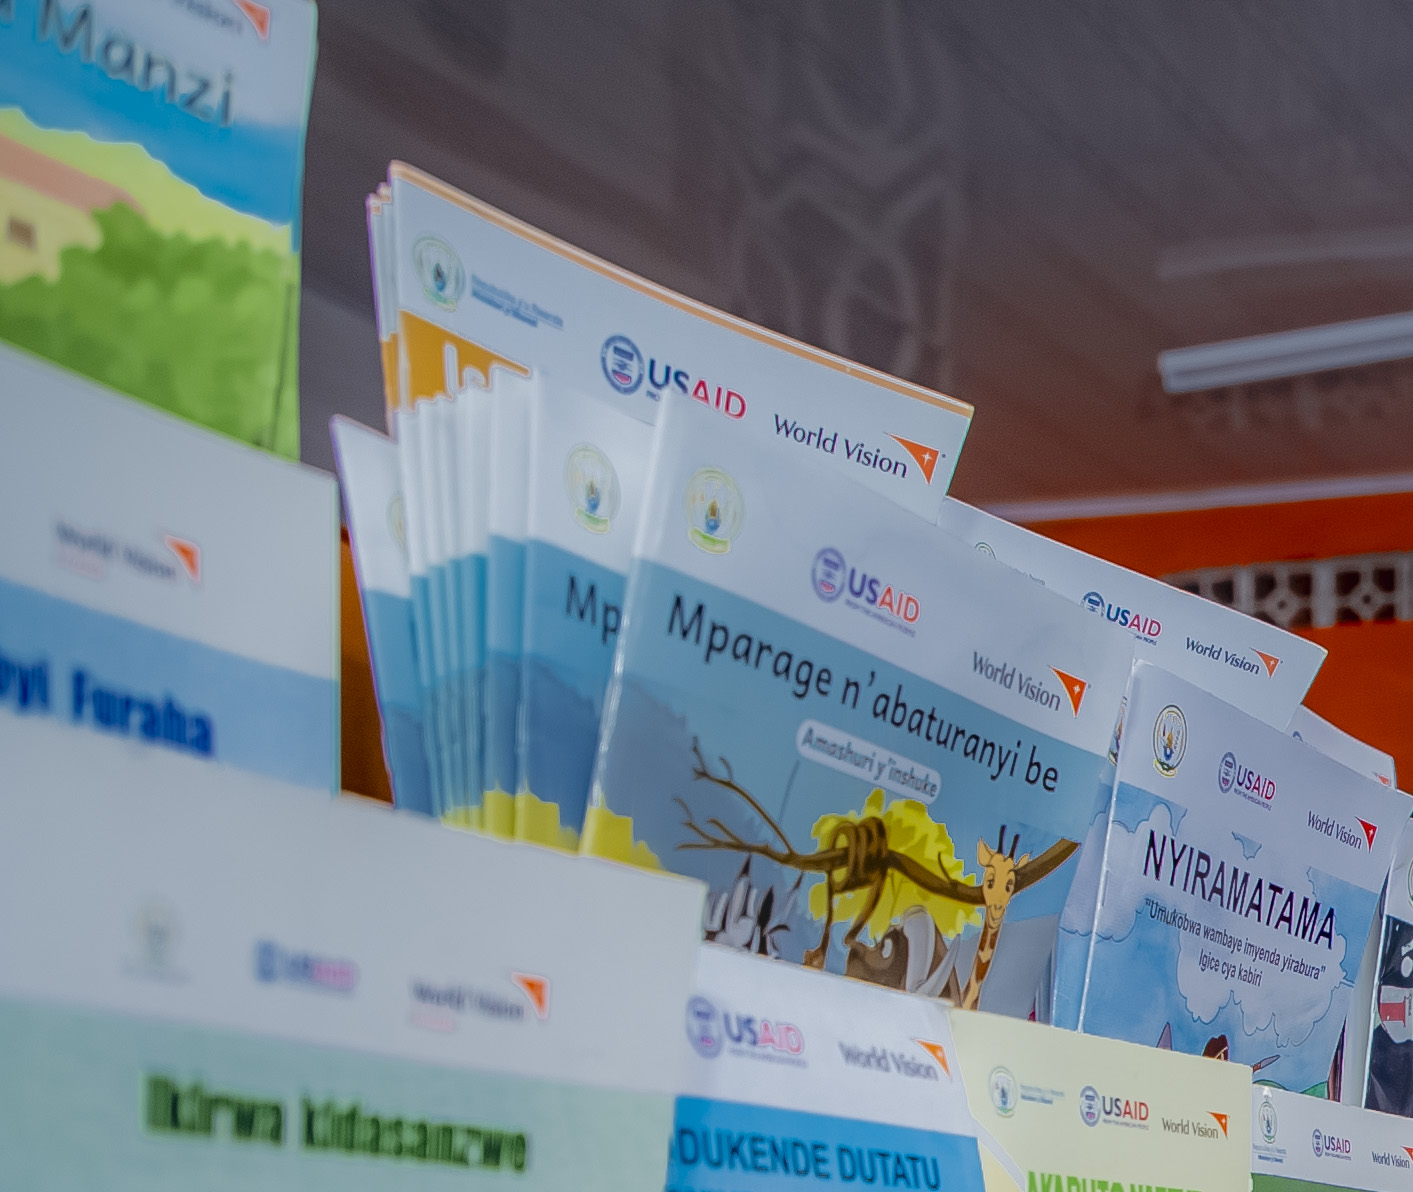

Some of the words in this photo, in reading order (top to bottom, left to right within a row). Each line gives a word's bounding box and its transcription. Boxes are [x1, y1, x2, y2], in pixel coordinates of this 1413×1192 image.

[37, 0, 233, 127] Manzi
[649, 358, 748, 420] USAID
[773, 413, 838, 455] World
[843, 438, 907, 479] Vision
[847, 567, 921, 625] USAID
[1106, 603, 1162, 637] USAID
[1185, 636, 1222, 661] World
[1223, 648, 1261, 675] Vision
[667, 594, 833, 700] Mparage
[841, 670, 1021, 783] n'abaturanyi
[1025, 745, 1059, 793] be
[971, 651, 1016, 690] World
[1018, 673, 1061, 712] Vision
[1237, 764, 1276, 801] USAID
[1308, 810, 1334, 836] World
[1335, 821, 1362, 849] Vision
[1143, 829, 1336, 950] NYIRAMATAMA
[1203, 925, 1243, 952] wambaye
[1243, 937, 1281, 967] imyenda
[1199, 948, 1220, 973] Igice
[1221, 960, 1237, 981] cya
[1237, 962, 1263, 988] kabiri
[723, 1012, 804, 1054] USAID
[839, 1042, 890, 1072] World
[893, 1050, 939, 1082] Vision
[1102, 1095, 1149, 1121] USAID
[1162, 1118, 1190, 1137] World
[1191, 1121, 1219, 1139] Vision
[1324, 1135, 1351, 1153] USAID
[1372, 1151, 1390, 1167] World
[1391, 1154, 1410, 1169] Vision
[836, 1147, 942, 1191] DUTATU
